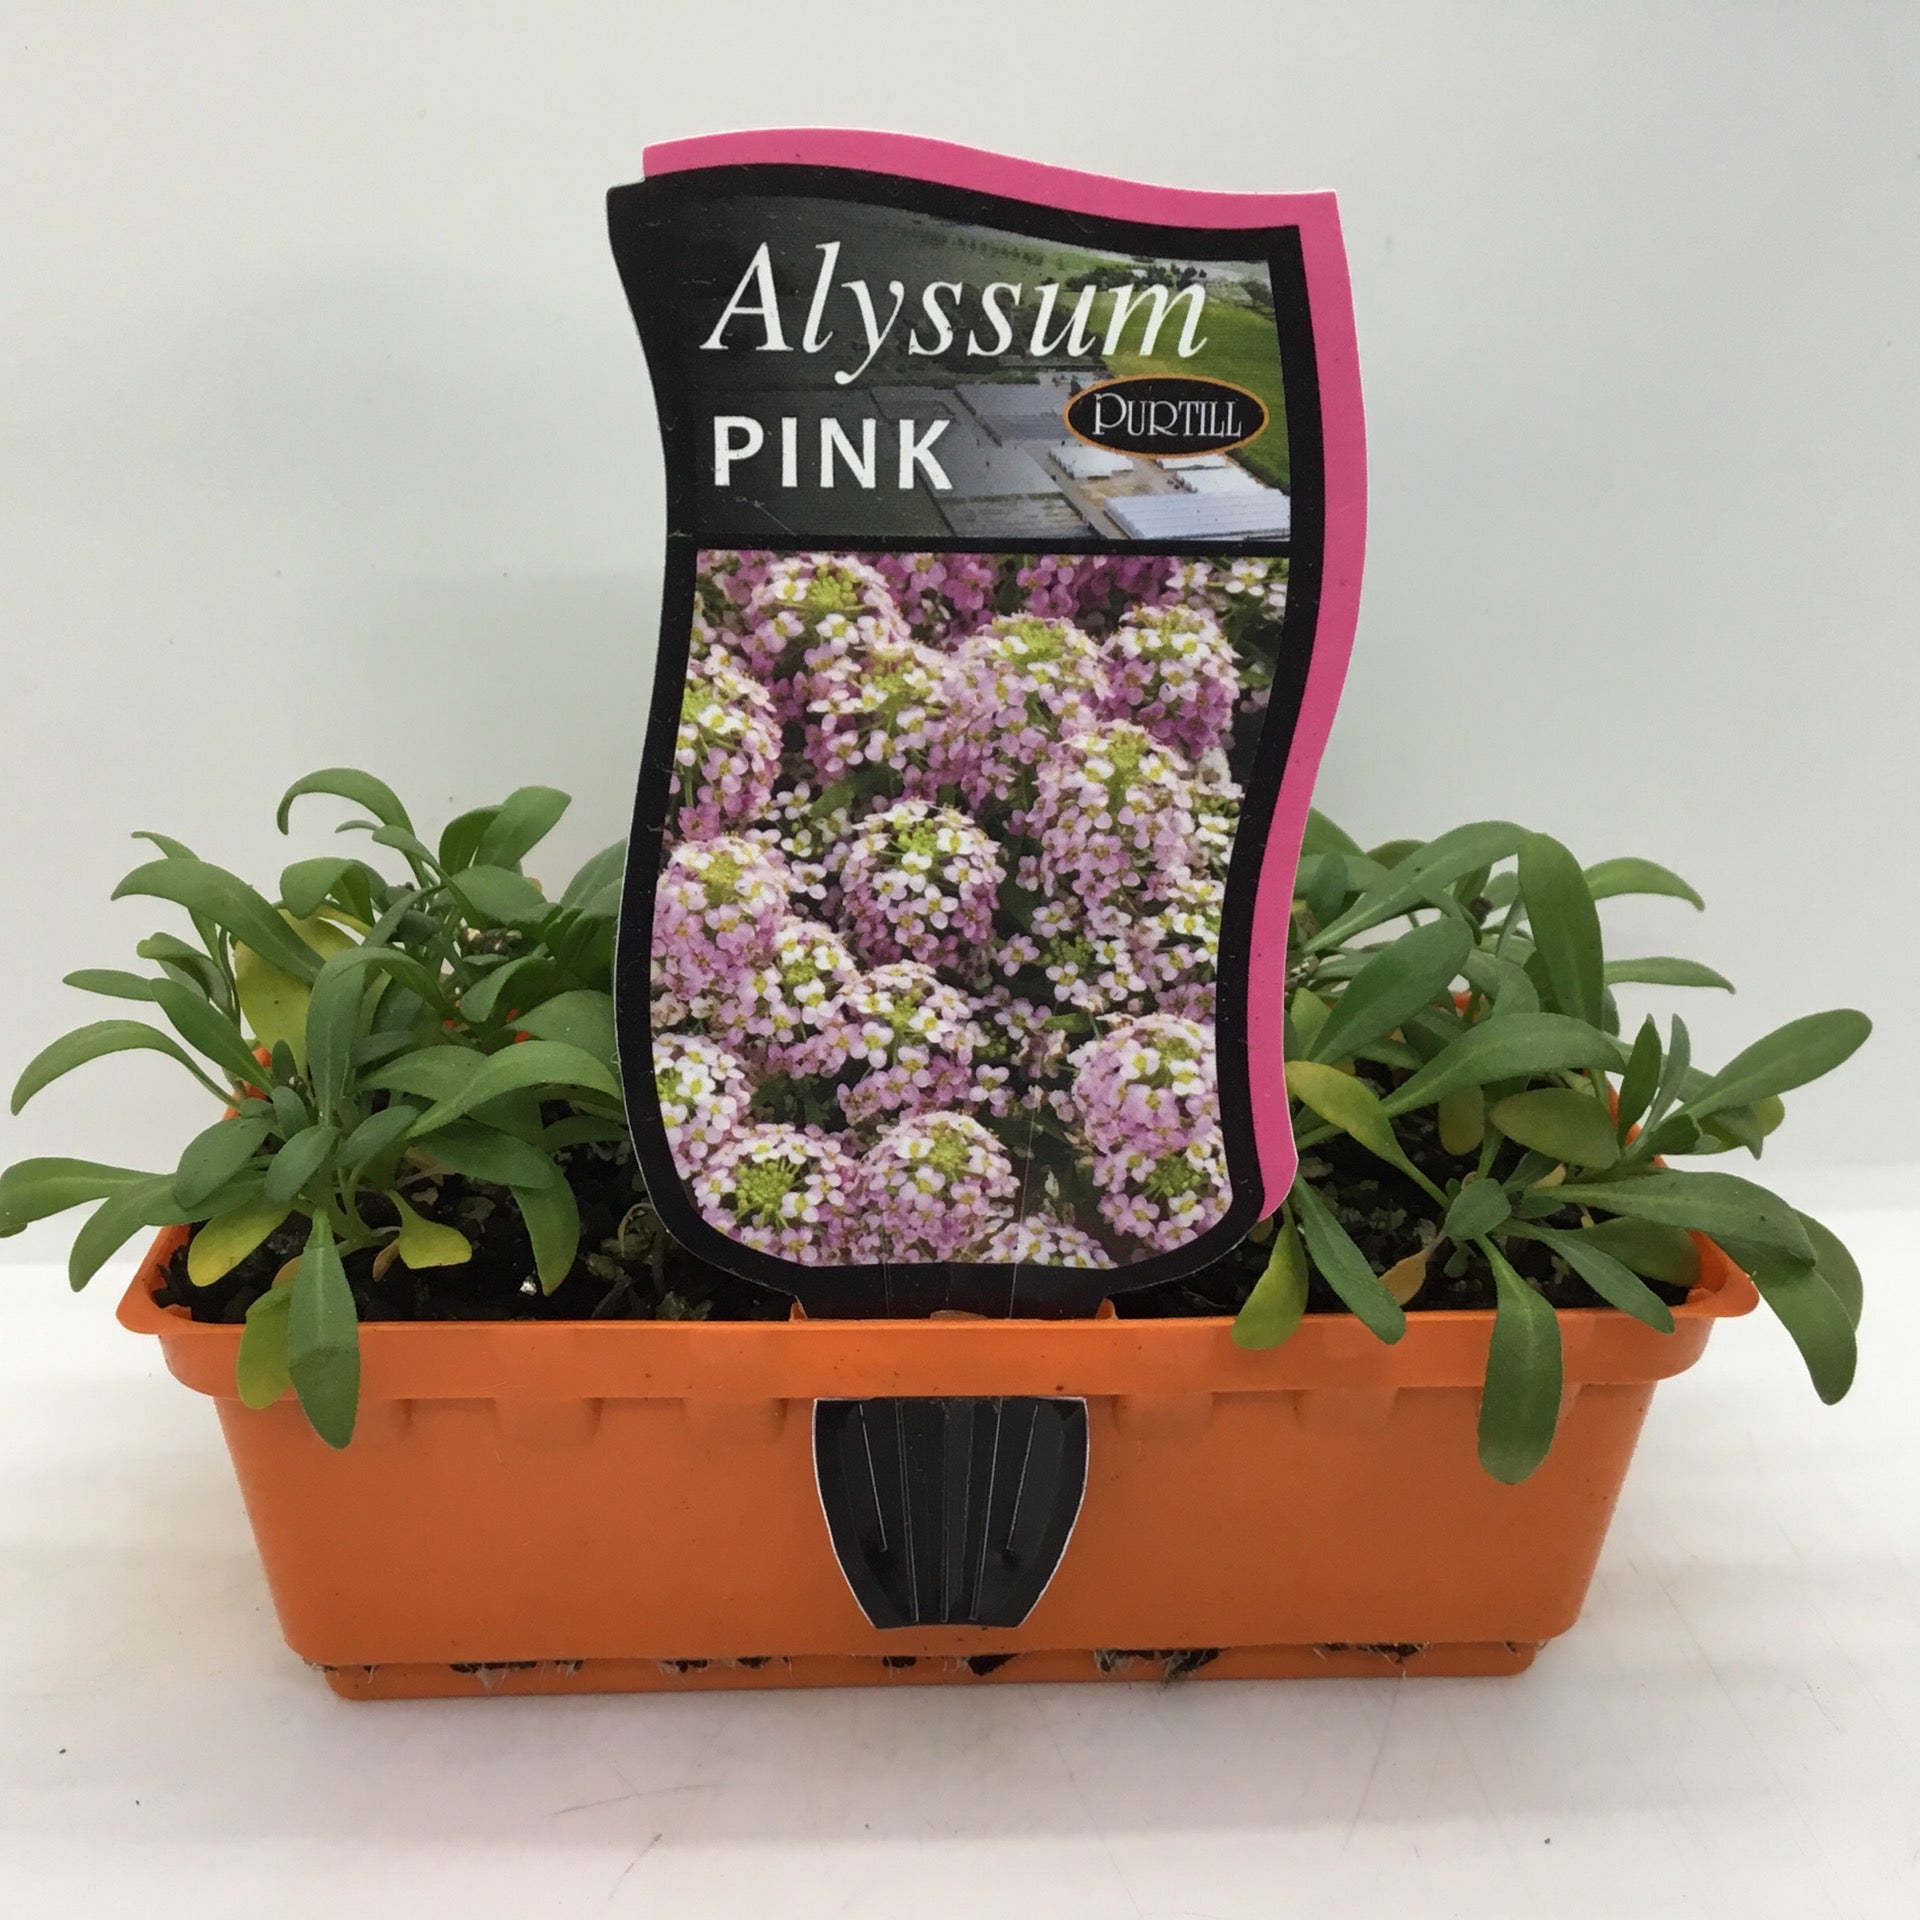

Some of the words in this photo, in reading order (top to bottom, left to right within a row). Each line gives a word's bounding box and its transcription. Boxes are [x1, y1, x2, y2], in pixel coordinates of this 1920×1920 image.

[699, 240, 1208, 385] Alyssum
[713, 415, 954, 491] PINK
[1091, 392, 1242, 438] PURTILL
